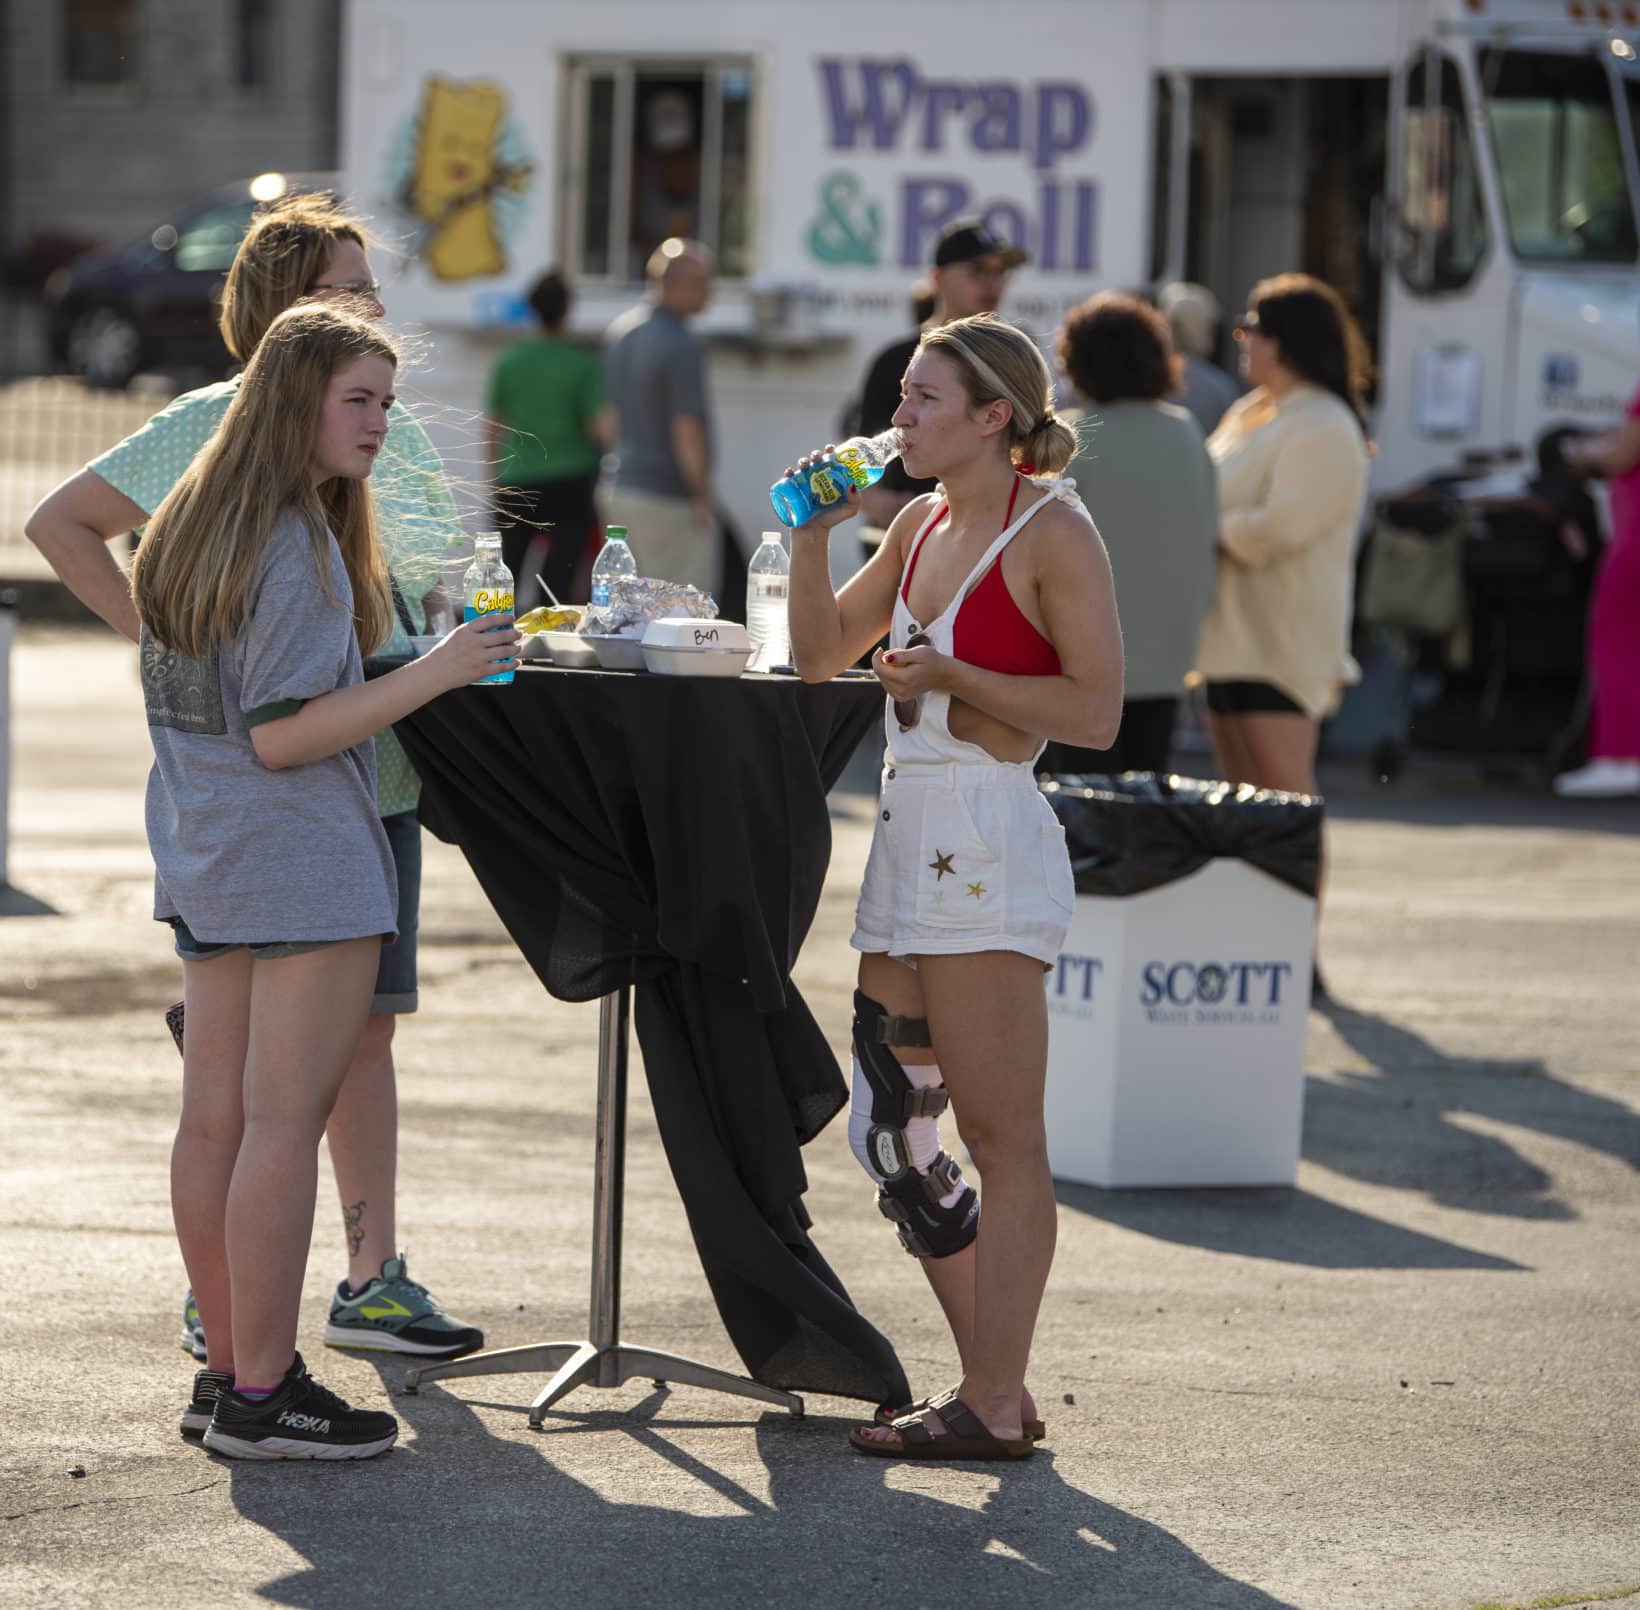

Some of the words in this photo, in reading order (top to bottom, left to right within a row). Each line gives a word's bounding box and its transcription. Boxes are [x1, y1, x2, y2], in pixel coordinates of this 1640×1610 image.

[816, 54, 1095, 169] Wrap
[805, 171, 880, 265] &
[900, 175, 1098, 273] Roll
[694, 629, 719, 646] Ben
[1140, 961, 1292, 1007] SCOTT
[276, 1410, 332, 1434] HOKA
